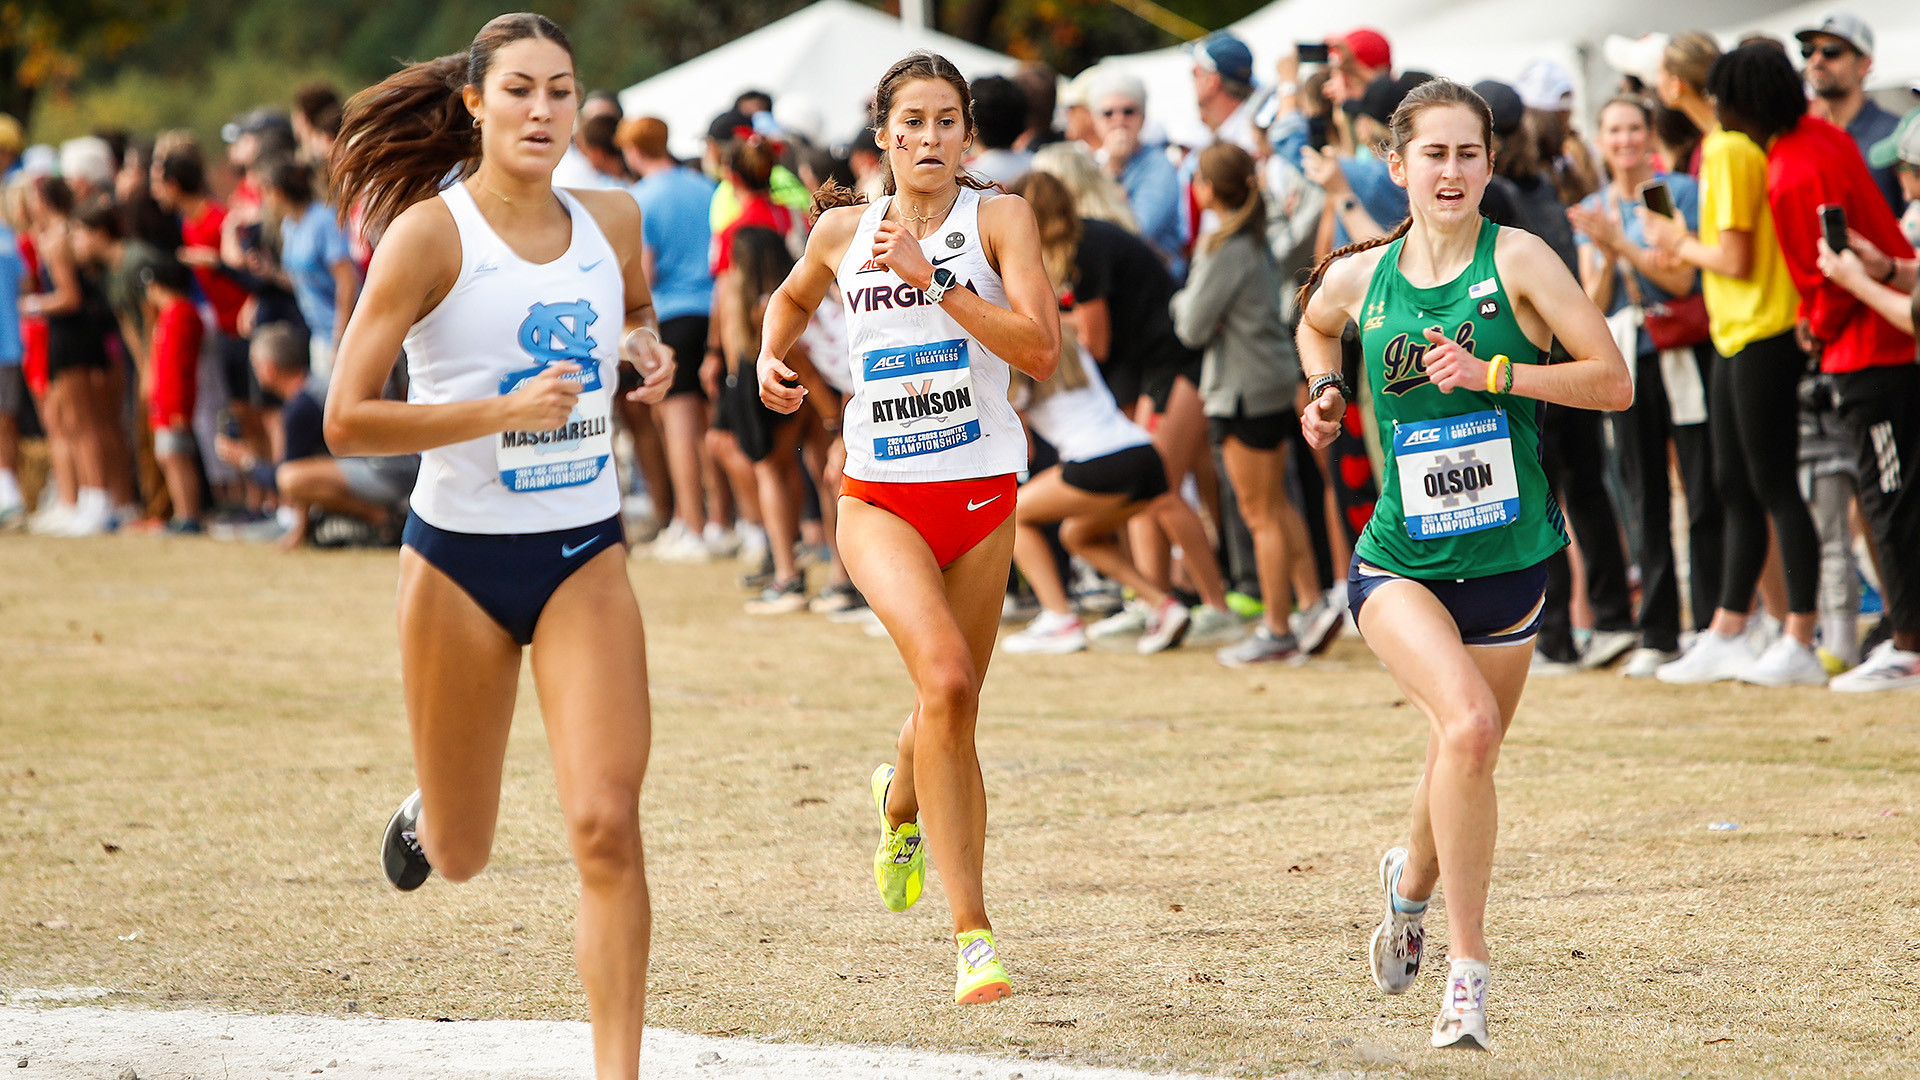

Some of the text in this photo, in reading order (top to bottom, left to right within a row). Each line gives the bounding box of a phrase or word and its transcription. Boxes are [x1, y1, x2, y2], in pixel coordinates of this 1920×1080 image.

[858, 259, 881, 273] AC
[1481, 303, 1497, 315] AB
[1364, 316, 1386, 330] ACC
[915, 353, 959, 365] GREATNESS
[1383, 320, 1476, 381] Irh
[871, 354, 906, 371] ACC
[872, 387, 972, 423] ATKINSON
[502, 416, 605, 448] MASCIARELLI
[887, 425, 966, 446] 2024 ACC CROSS COUNTRY
[1404, 428, 1441, 445] ACC
[1451, 422, 1497, 439] GREATNESS
[887, 432, 968, 456] CHAMPIONSHIPS
[515, 467, 598, 490] CHAMPIONSHIPS
[1424, 464, 1493, 497] OLSON
[1440, 513, 1453, 522] ACC
[1453, 508, 1475, 519] CROSS
[1475, 502, 1504, 515] COUNTRY
[1421, 510, 1507, 535] CHAMPIONSHIPS
